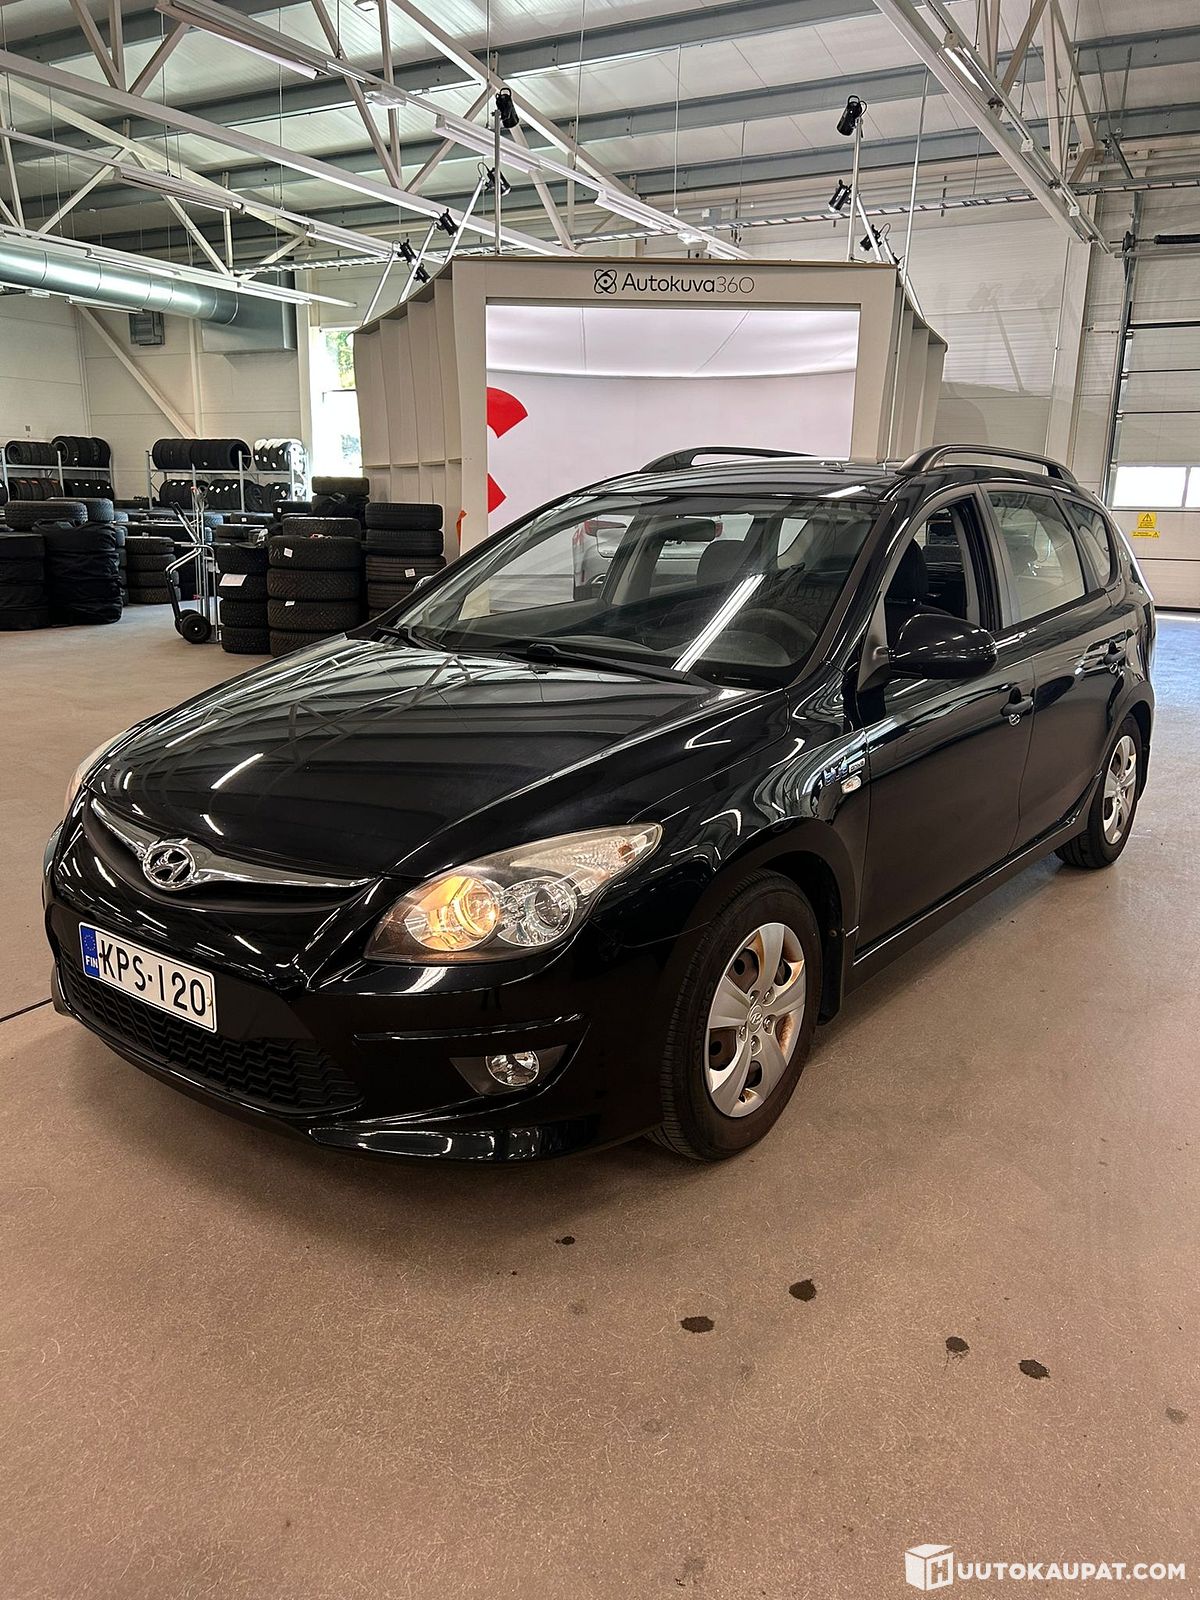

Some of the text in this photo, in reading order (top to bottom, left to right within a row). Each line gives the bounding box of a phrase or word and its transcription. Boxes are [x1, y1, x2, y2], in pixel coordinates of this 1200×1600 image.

[621, 273, 755, 294] Autokuva360
[85, 955, 99, 969] FIN
[100, 939, 206, 1017] KPS-120
